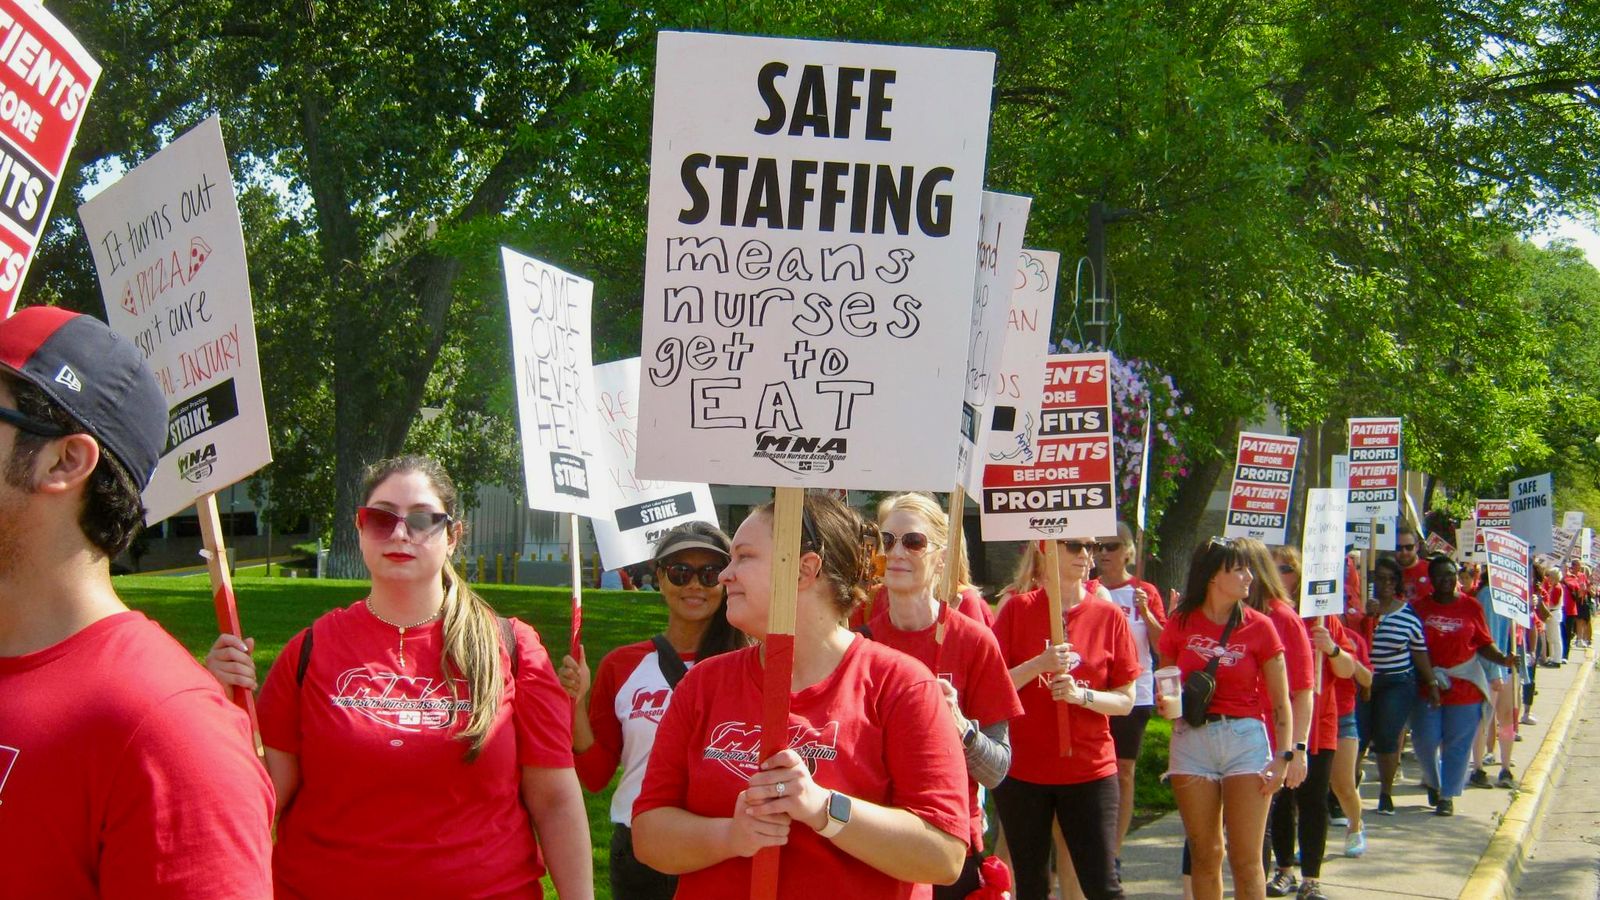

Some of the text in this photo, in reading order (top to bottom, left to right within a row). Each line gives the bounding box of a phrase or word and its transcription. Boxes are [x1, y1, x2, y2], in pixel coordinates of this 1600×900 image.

[0, 80, 43, 143] ORE
[754, 61, 896, 141] SAFE
[678, 153, 954, 238] STAFFING
[102, 173, 216, 276] It turns out
[666, 236, 915, 283] means
[136, 250, 186, 313] PIZZA
[522, 261, 580, 335] SOME
[169, 290, 213, 336] cure
[664, 285, 922, 338] nurses
[178, 323, 242, 389] INJURY
[649, 332, 849, 387] get to
[524, 354, 589, 413] NEVER
[691, 377, 874, 432] EAT
[169, 403, 213, 447] STRIKE
[1352, 424, 1399, 435] PATIENTS
[757, 435, 847, 453] MNA
[1241, 440, 1297, 455] PATIENTS
[1352, 448, 1397, 460] PROFITS
[787, 453, 809, 461] Nurses
[1013, 467, 1080, 482] BEFORE
[1240, 467, 1289, 482] PROFITS
[1350, 465, 1397, 477] PATIENTS
[1233, 485, 1289, 500] PATIENTS
[1351, 490, 1395, 502] PROFITS
[1517, 479, 1537, 496] SAFE
[991, 488, 1104, 511] PROFITS
[1511, 494, 1547, 514] STAFFING
[640, 503, 678, 524] STRIKE
[1029, 517, 1068, 526] MNA
[1232, 512, 1282, 527] PROFITS
[1486, 533, 1527, 555] PATIENTS
[1491, 554, 1526, 575] PROFITS
[1494, 589, 1527, 611] PROFITS
[380, 700, 414, 710] Nurses
